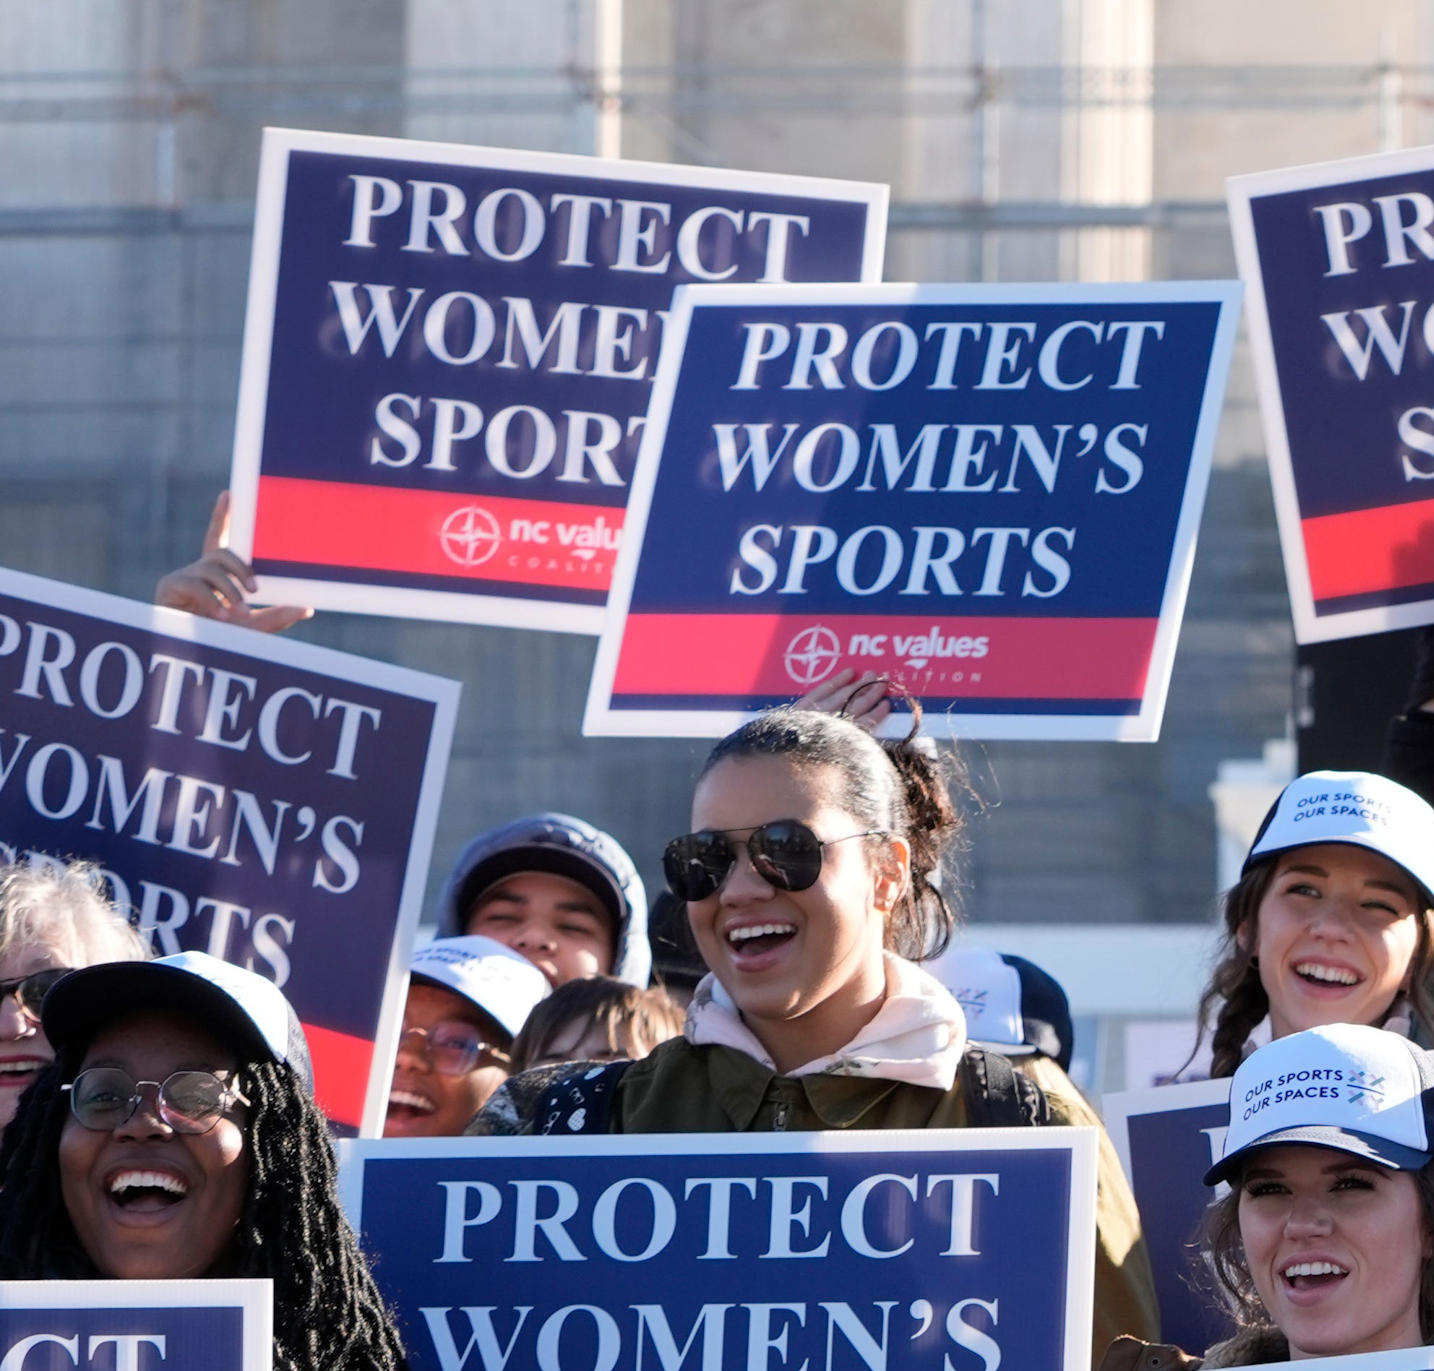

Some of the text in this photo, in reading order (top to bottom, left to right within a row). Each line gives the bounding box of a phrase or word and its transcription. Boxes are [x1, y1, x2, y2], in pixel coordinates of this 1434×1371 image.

[341, 174, 809, 283] PROTECT
[330, 281, 672, 381] WOME
[730, 321, 1165, 391] PROTECT
[370, 393, 648, 487] SPOR
[713, 423, 1148, 494] WOMEN'S
[510, 516, 625, 548] nc valu
[730, 525, 1076, 598] SPORTS
[848, 626, 989, 658] nc values
[1293, 807, 1325, 822] OUR
[1297, 794, 1328, 808] OUR
[1243, 1086, 1339, 1121] OUR SPACES
[1245, 1069, 1343, 1102] OUR SPORTS
[433, 1173, 1000, 1263] PROTECT
